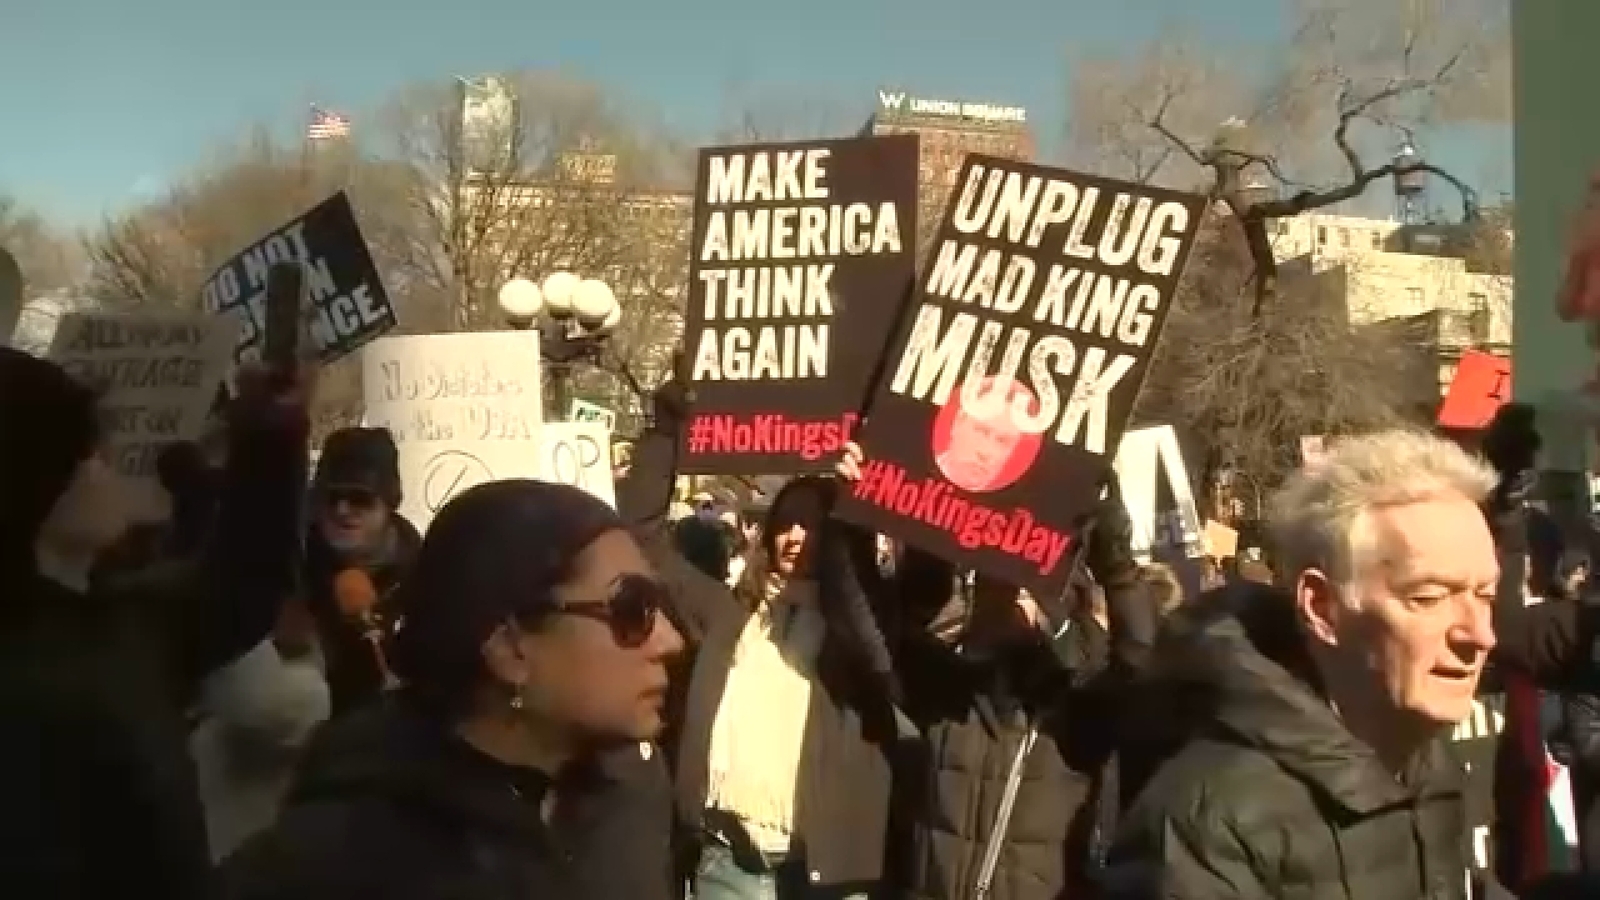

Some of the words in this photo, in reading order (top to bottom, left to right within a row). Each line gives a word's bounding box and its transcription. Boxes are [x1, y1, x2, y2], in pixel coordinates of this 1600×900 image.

[707, 149, 830, 203] MAKE
[700, 202, 901, 260] AMERICA
[953, 164, 1188, 276] UNPLUG
[242, 222, 310, 288] NOT
[699, 265, 836, 320] THINK
[926, 240, 1036, 314] MAD
[1032, 265, 1161, 347] KING
[692, 324, 829, 381] AGAIN
[889, 305, 1136, 454] MUSK
[853, 459, 1071, 576] #NoKingsDay
